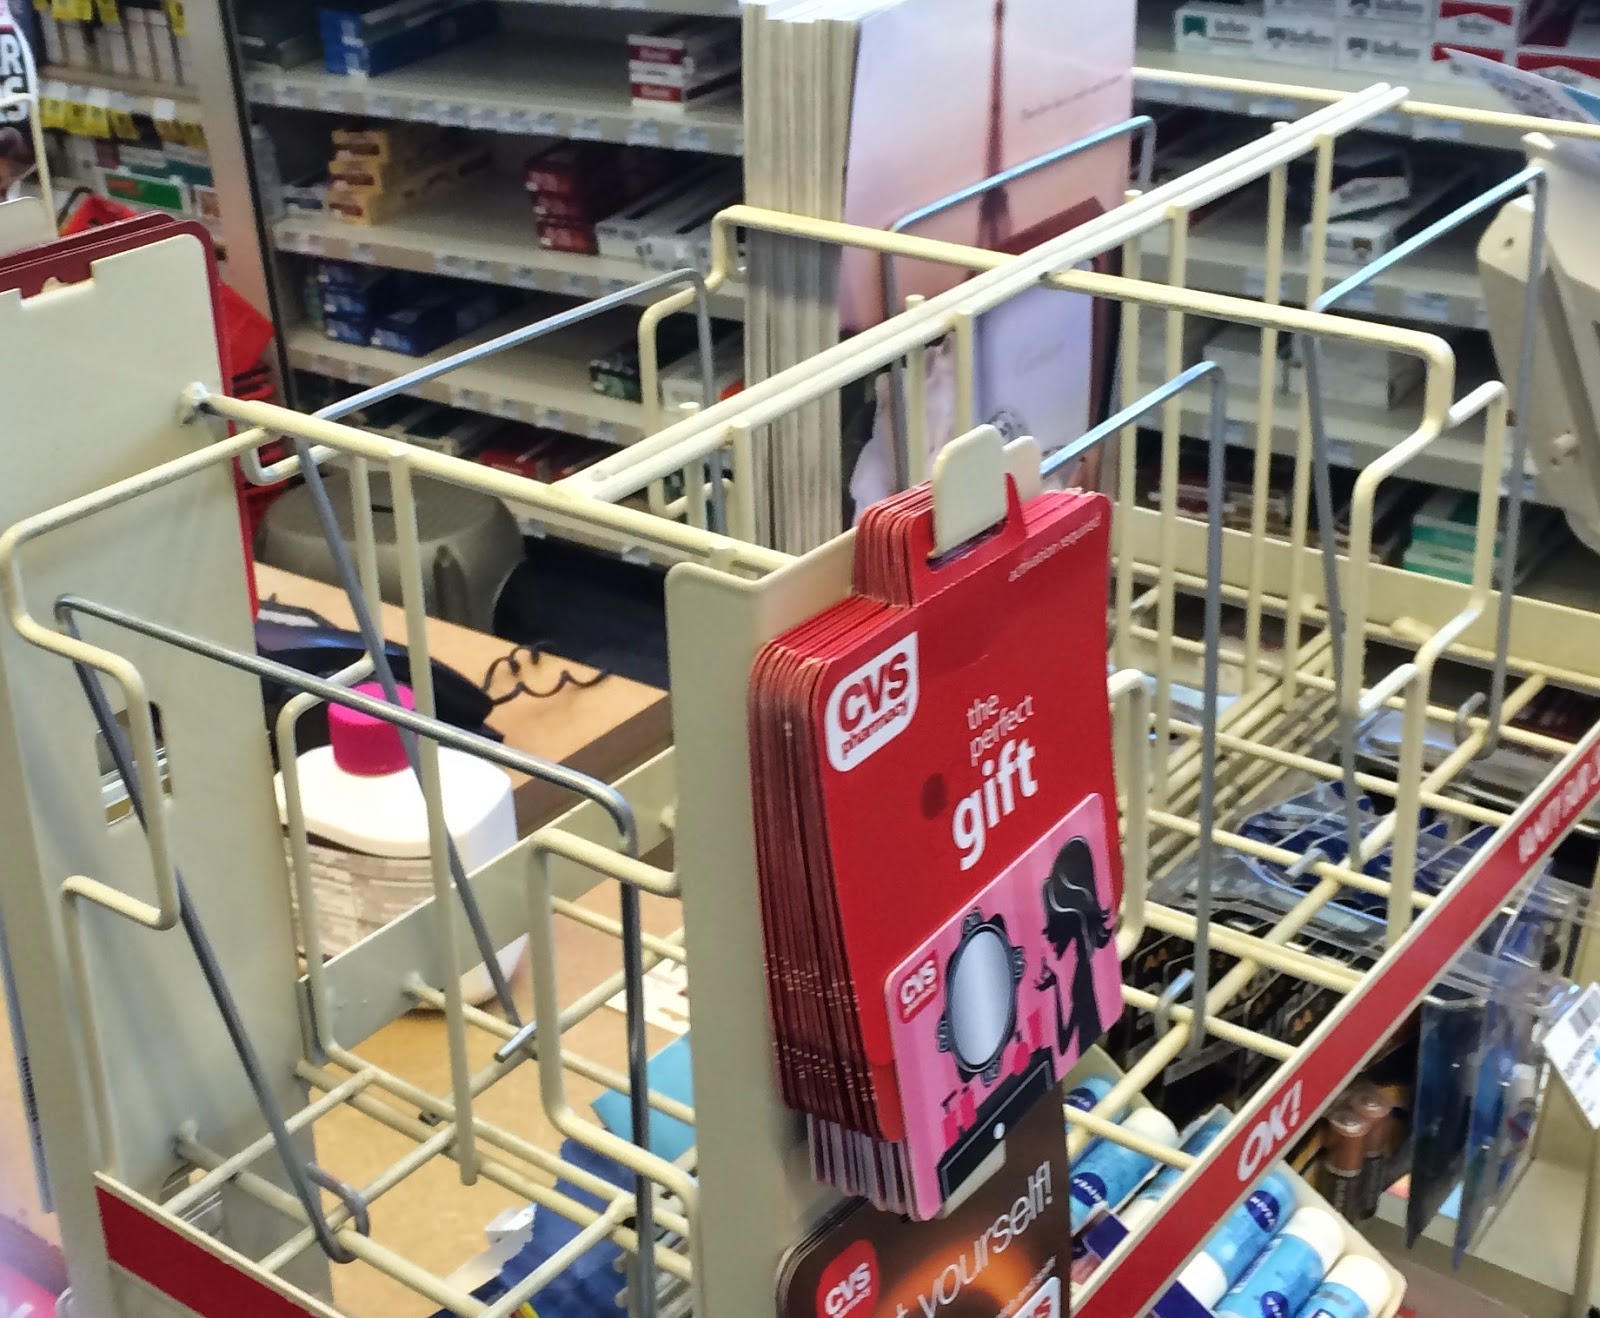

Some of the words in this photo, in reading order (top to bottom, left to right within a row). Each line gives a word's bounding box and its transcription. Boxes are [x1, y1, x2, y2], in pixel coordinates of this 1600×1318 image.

[838, 652, 909, 734] CVS
[966, 694, 999, 730] the
[970, 695, 1035, 767] perfect
[952, 738, 1038, 871] gift
[1237, 1080, 1303, 1181] OK!
[824, 1261, 872, 1316] CVS
